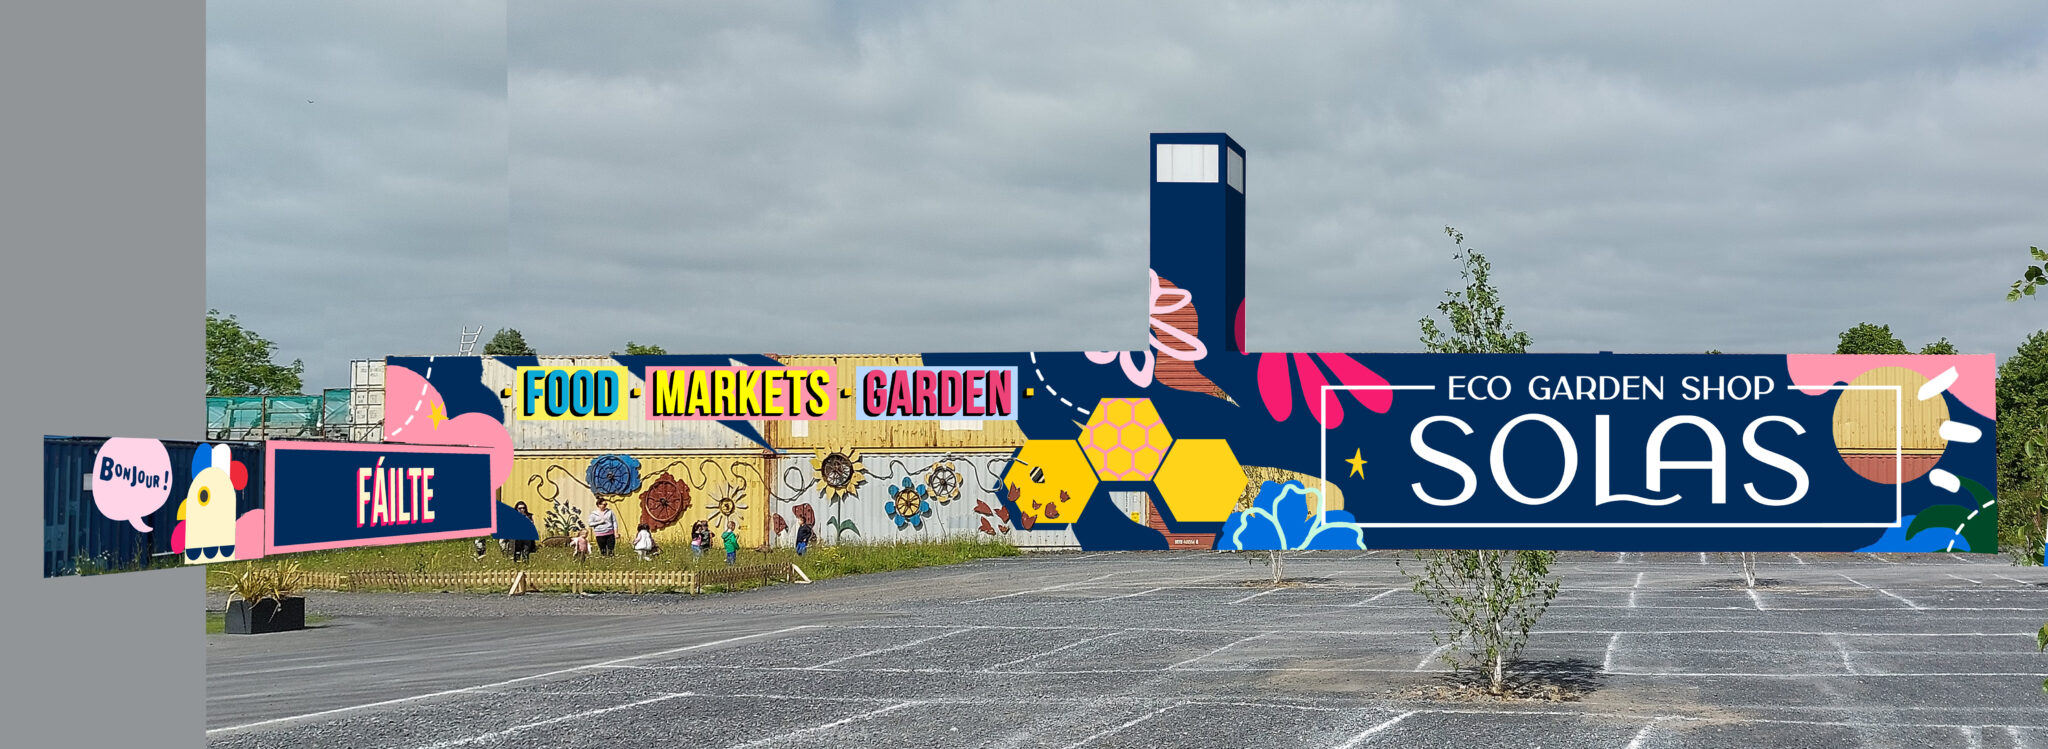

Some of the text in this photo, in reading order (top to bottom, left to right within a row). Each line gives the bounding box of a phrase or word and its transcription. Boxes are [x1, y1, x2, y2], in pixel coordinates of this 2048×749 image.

[524, 370, 1012, 417] FOOD MARKETS GARDEN
[1448, 375, 1775, 401] ECO GARDEN SHOP
[1410, 413, 1810, 507] SOLAS
[356, 456, 435, 528] FÁILTE
